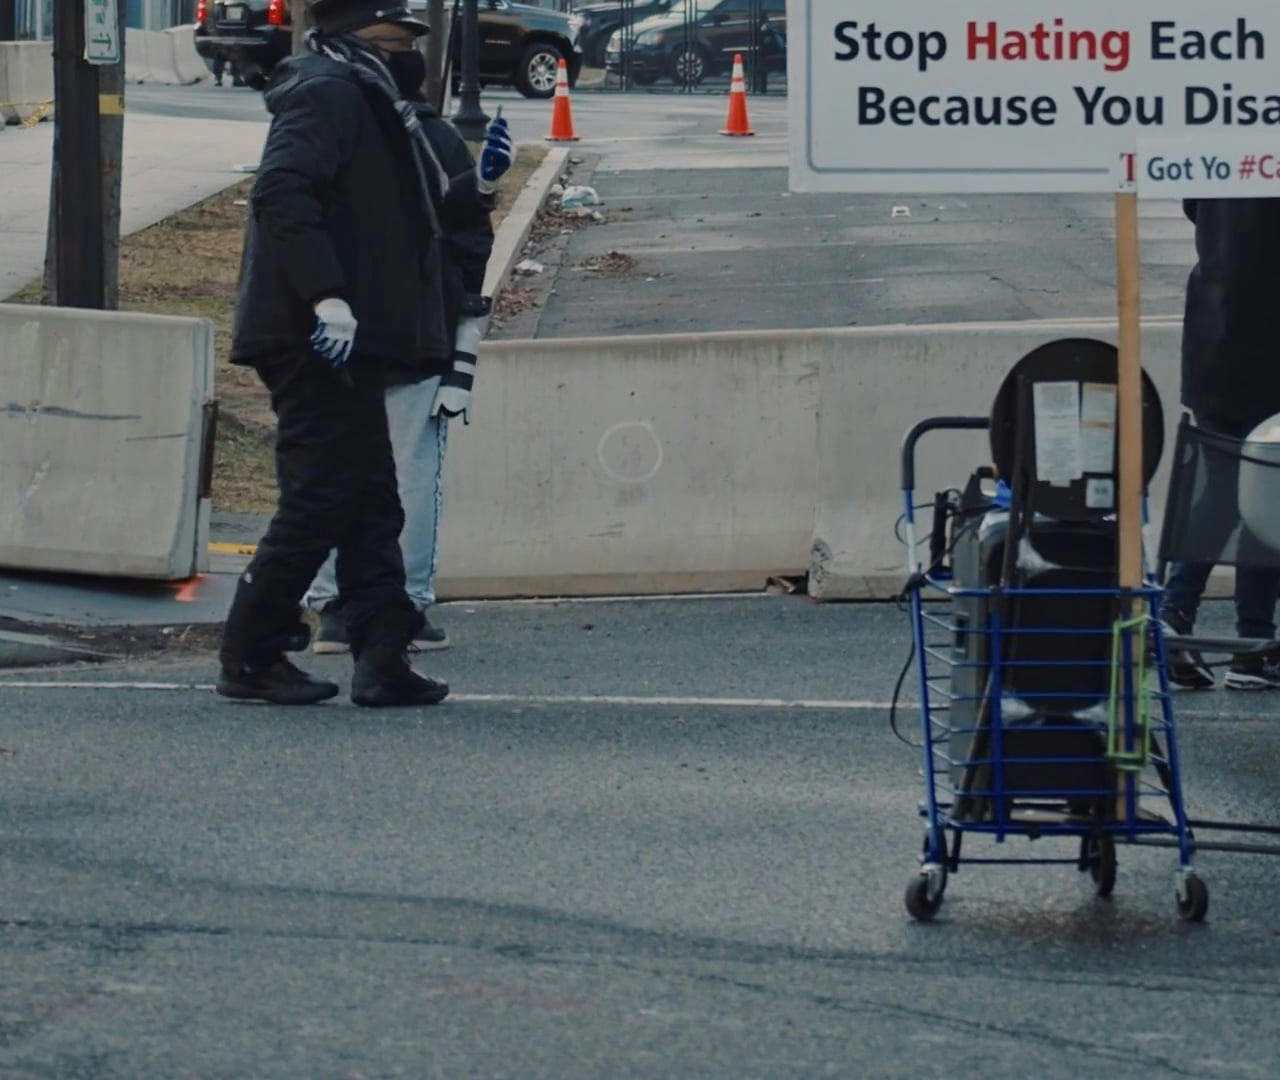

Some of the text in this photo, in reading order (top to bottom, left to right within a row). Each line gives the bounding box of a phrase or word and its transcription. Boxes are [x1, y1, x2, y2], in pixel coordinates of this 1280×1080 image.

[833, 21, 948, 71] Stop
[967, 20, 1131, 72] Hating
[1150, 17, 1265, 61] Each
[857, 86, 1058, 126] Because
[1073, 86, 1164, 126] You
[1147, 156, 1194, 181] Got
[1200, 156, 1232, 180] Yo
